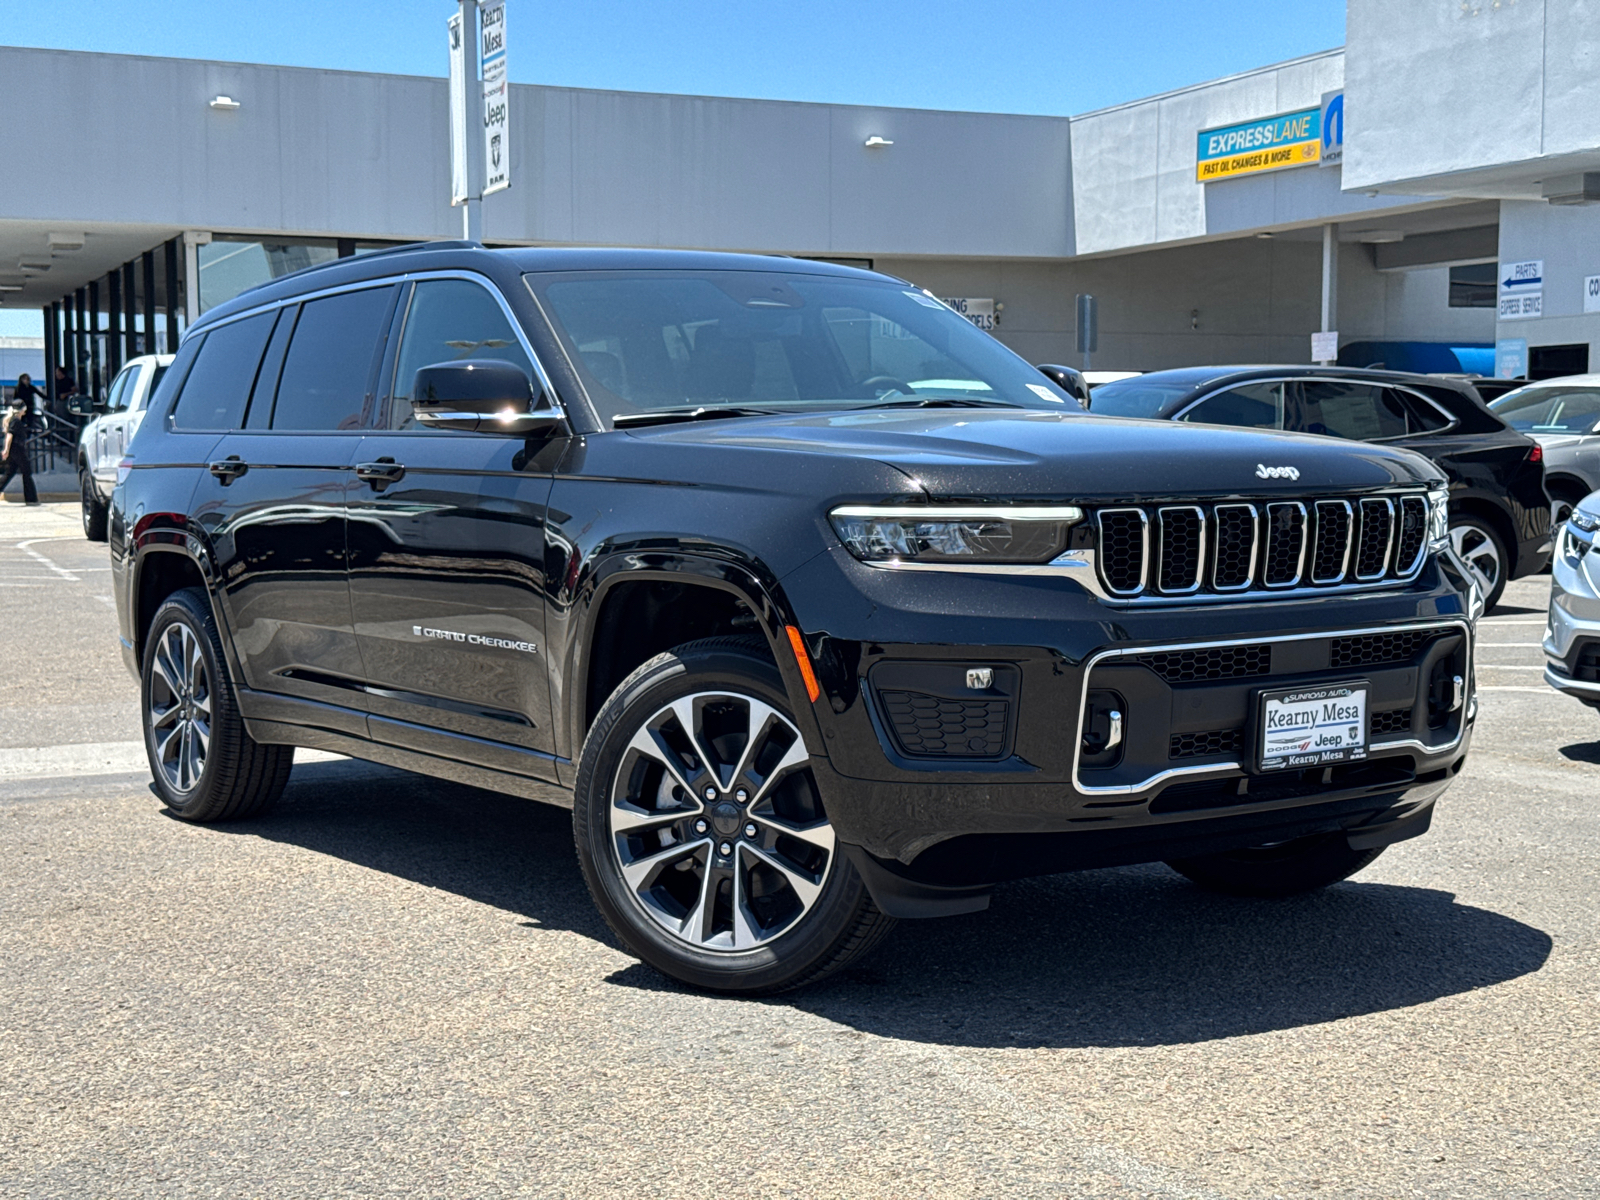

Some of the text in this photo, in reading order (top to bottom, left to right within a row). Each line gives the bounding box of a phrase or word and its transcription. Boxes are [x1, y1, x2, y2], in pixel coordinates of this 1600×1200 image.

[484, 31, 503, 56] Mesa
[484, 102, 506, 128] Jeep
[1203, 164, 1219, 175] FAST
[1220, 161, 1230, 172] OIL
[1231, 155, 1263, 170] CHANGES
[1270, 149, 1293, 164] MORE
[489, 173, 505, 186] RAM
[1515, 263, 1538, 278] PARTS
[1255, 463, 1300, 482] Jeep
[424, 628, 538, 653] GRAND CHEROKEE
[1288, 688, 1347, 701] SUNROAD AUTO
[1267, 703, 1359, 729] Kearny Mesa
[1315, 734, 1343, 748] Jeep
[1289, 754, 1319, 765] Kearny
[1321, 751, 1344, 761] Mesa
